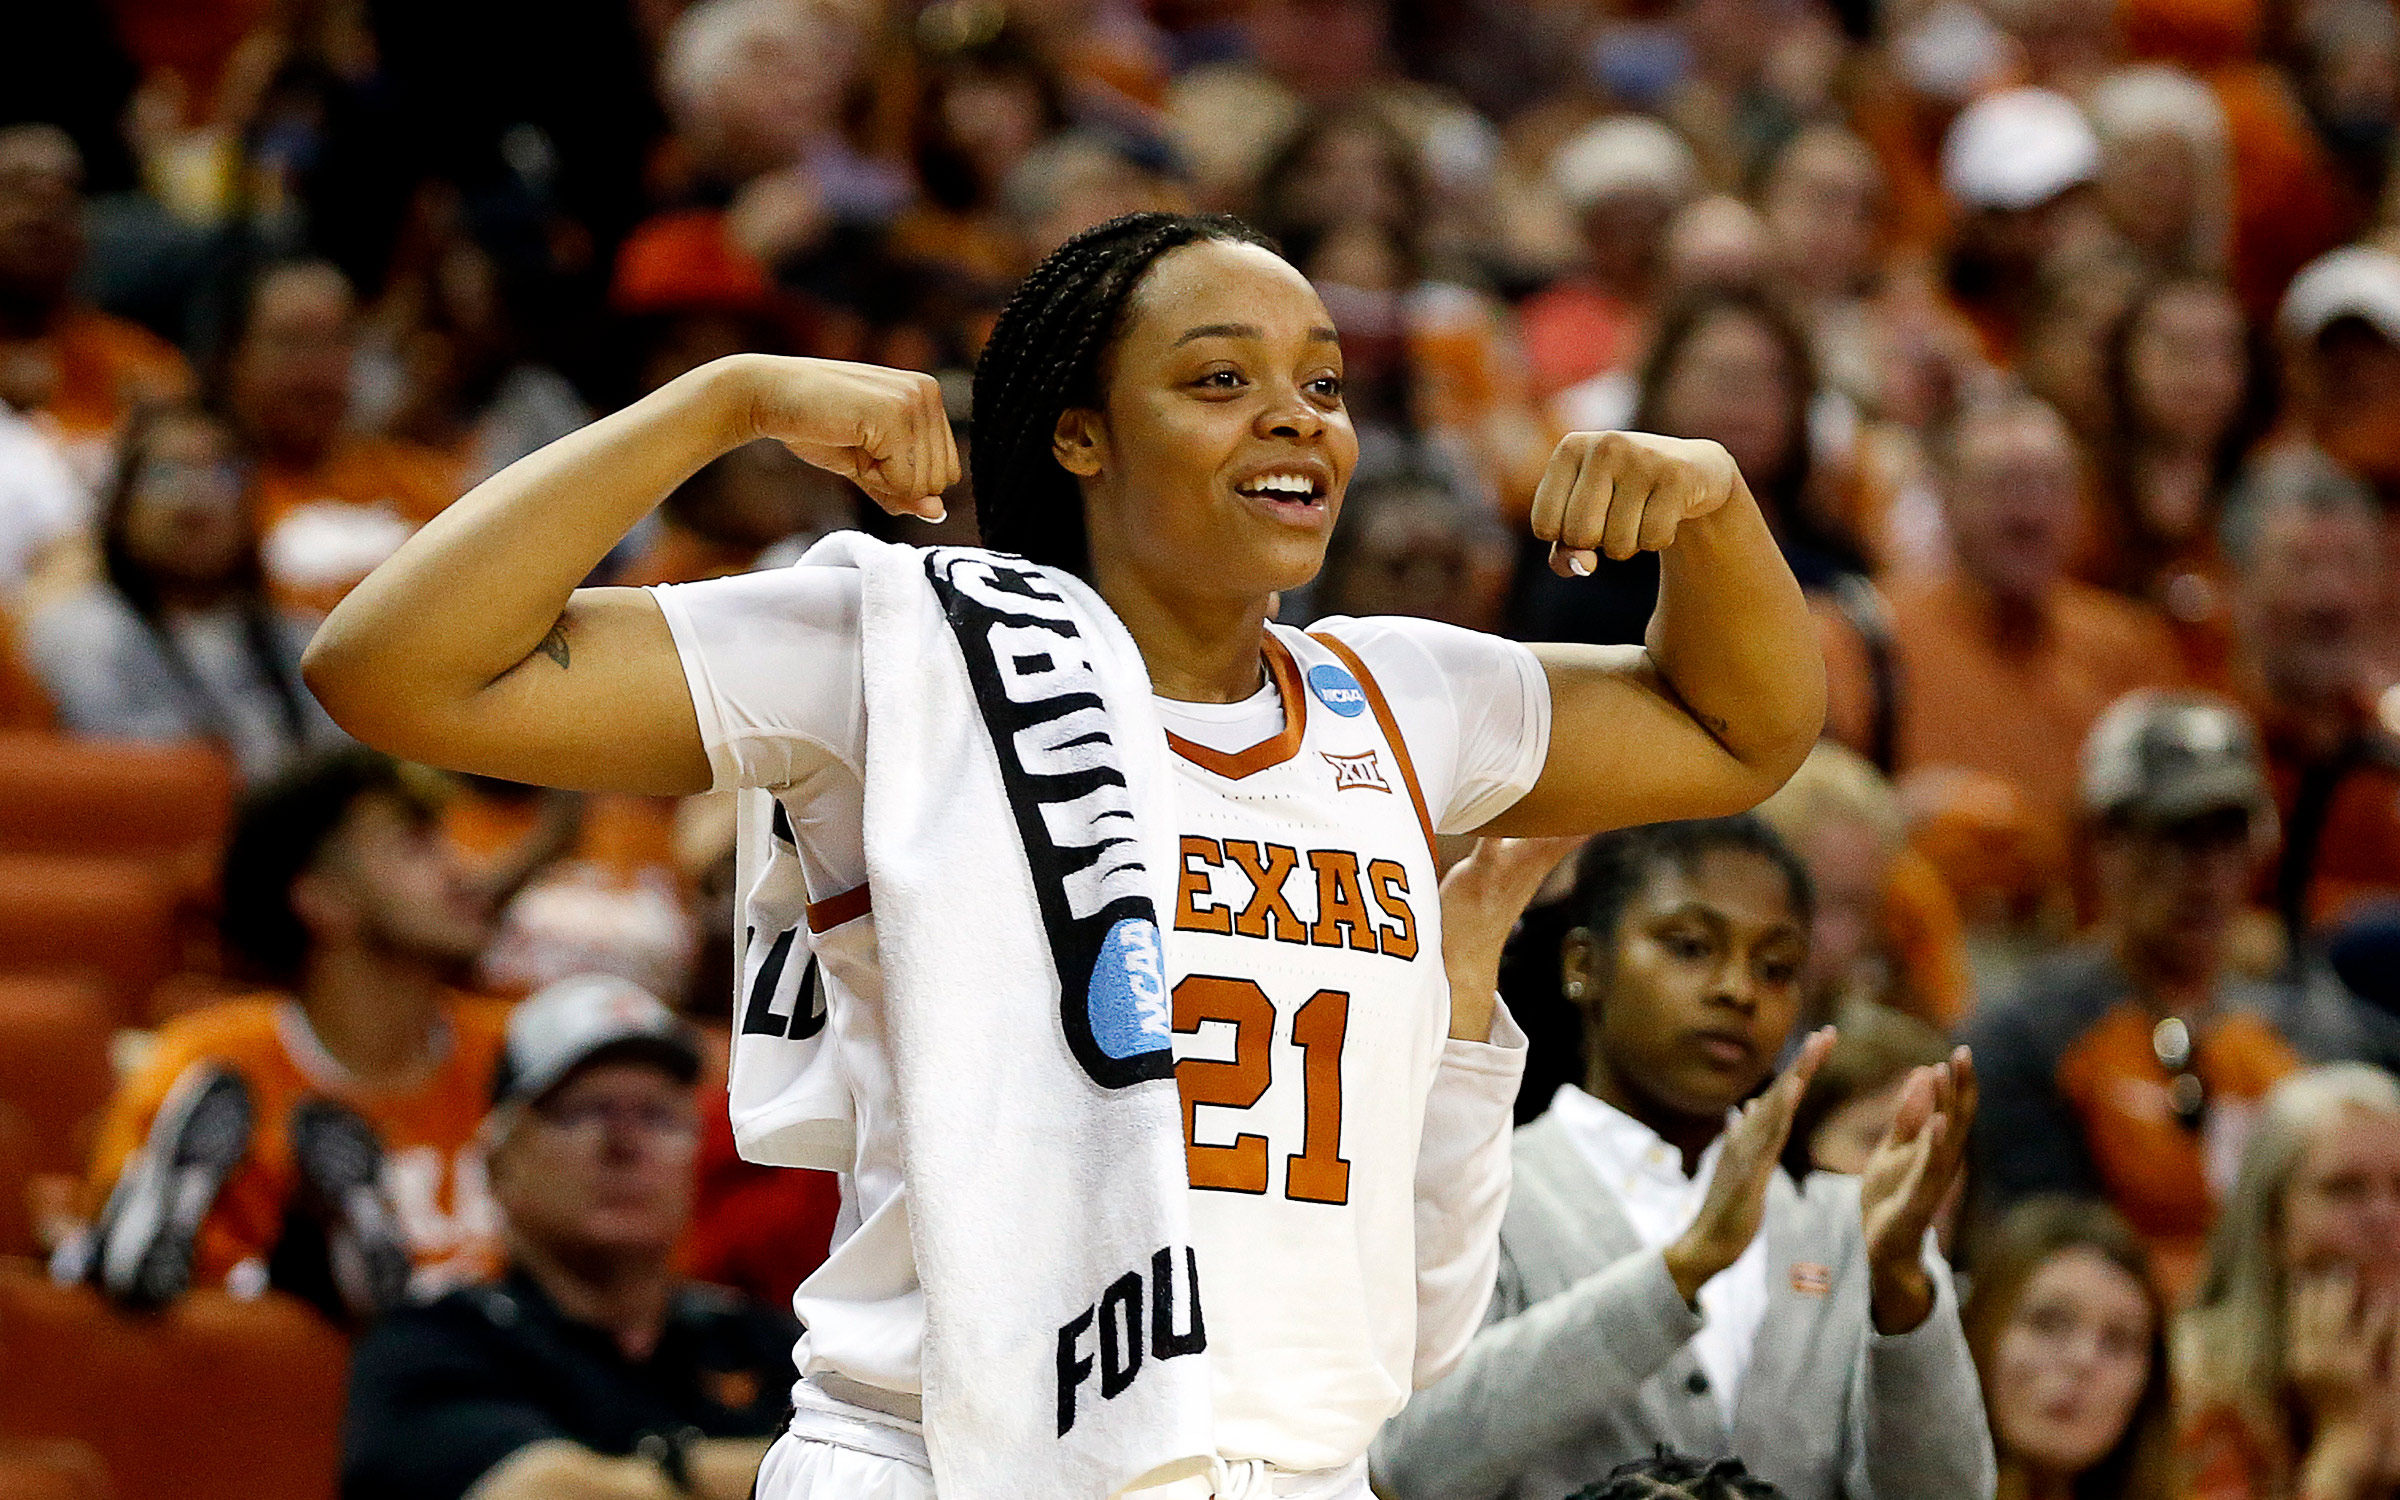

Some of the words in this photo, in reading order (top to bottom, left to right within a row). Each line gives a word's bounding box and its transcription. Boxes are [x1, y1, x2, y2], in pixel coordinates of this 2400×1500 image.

[1321, 687, 1364, 702] NCAA
[1173, 834, 1419, 962] EXAS
[1119, 920, 1171, 1037] NCAA
[1171, 973, 1350, 1206] 21
